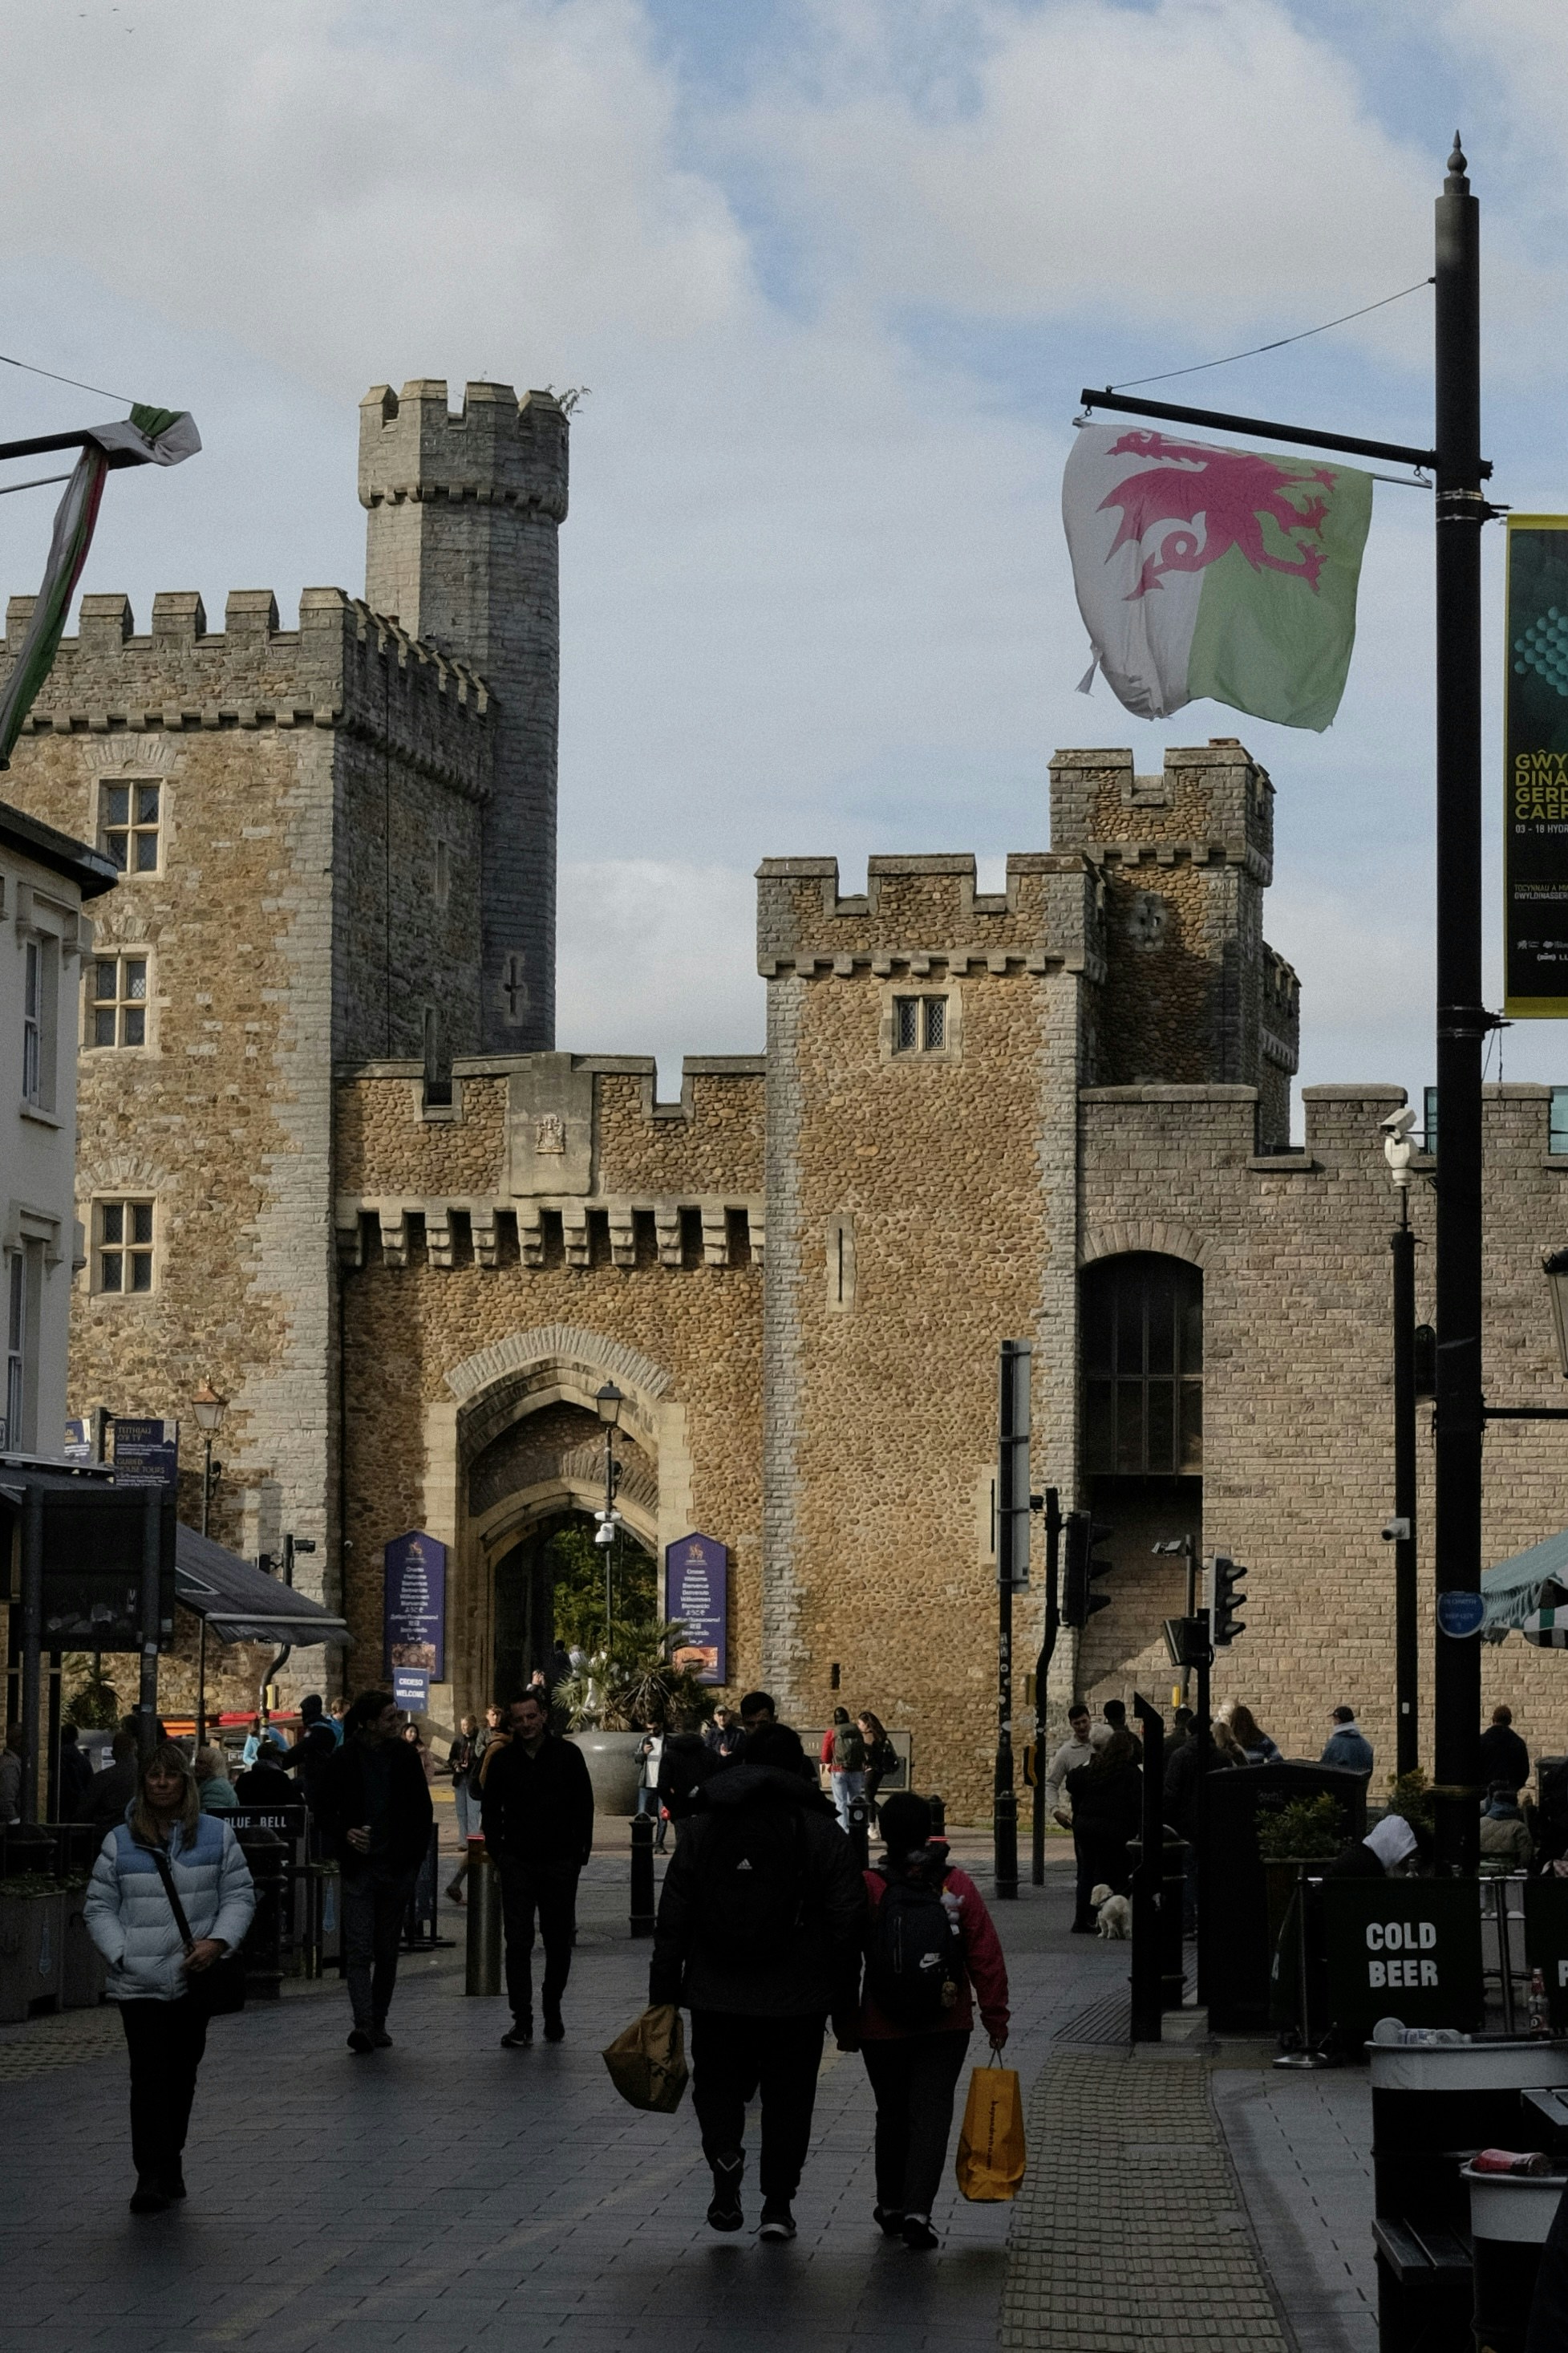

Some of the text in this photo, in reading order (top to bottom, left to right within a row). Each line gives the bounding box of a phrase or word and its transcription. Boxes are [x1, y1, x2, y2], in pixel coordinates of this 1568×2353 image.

[1515, 824, 1525, 834] 03
[1535, 824, 1545, 834] 18
[395, 1689, 426, 1698] WELCOME
[260, 1815, 287, 1828] BELL
[1365, 1921, 1437, 1952] COLD
[1367, 1959, 1439, 1988] BEER
